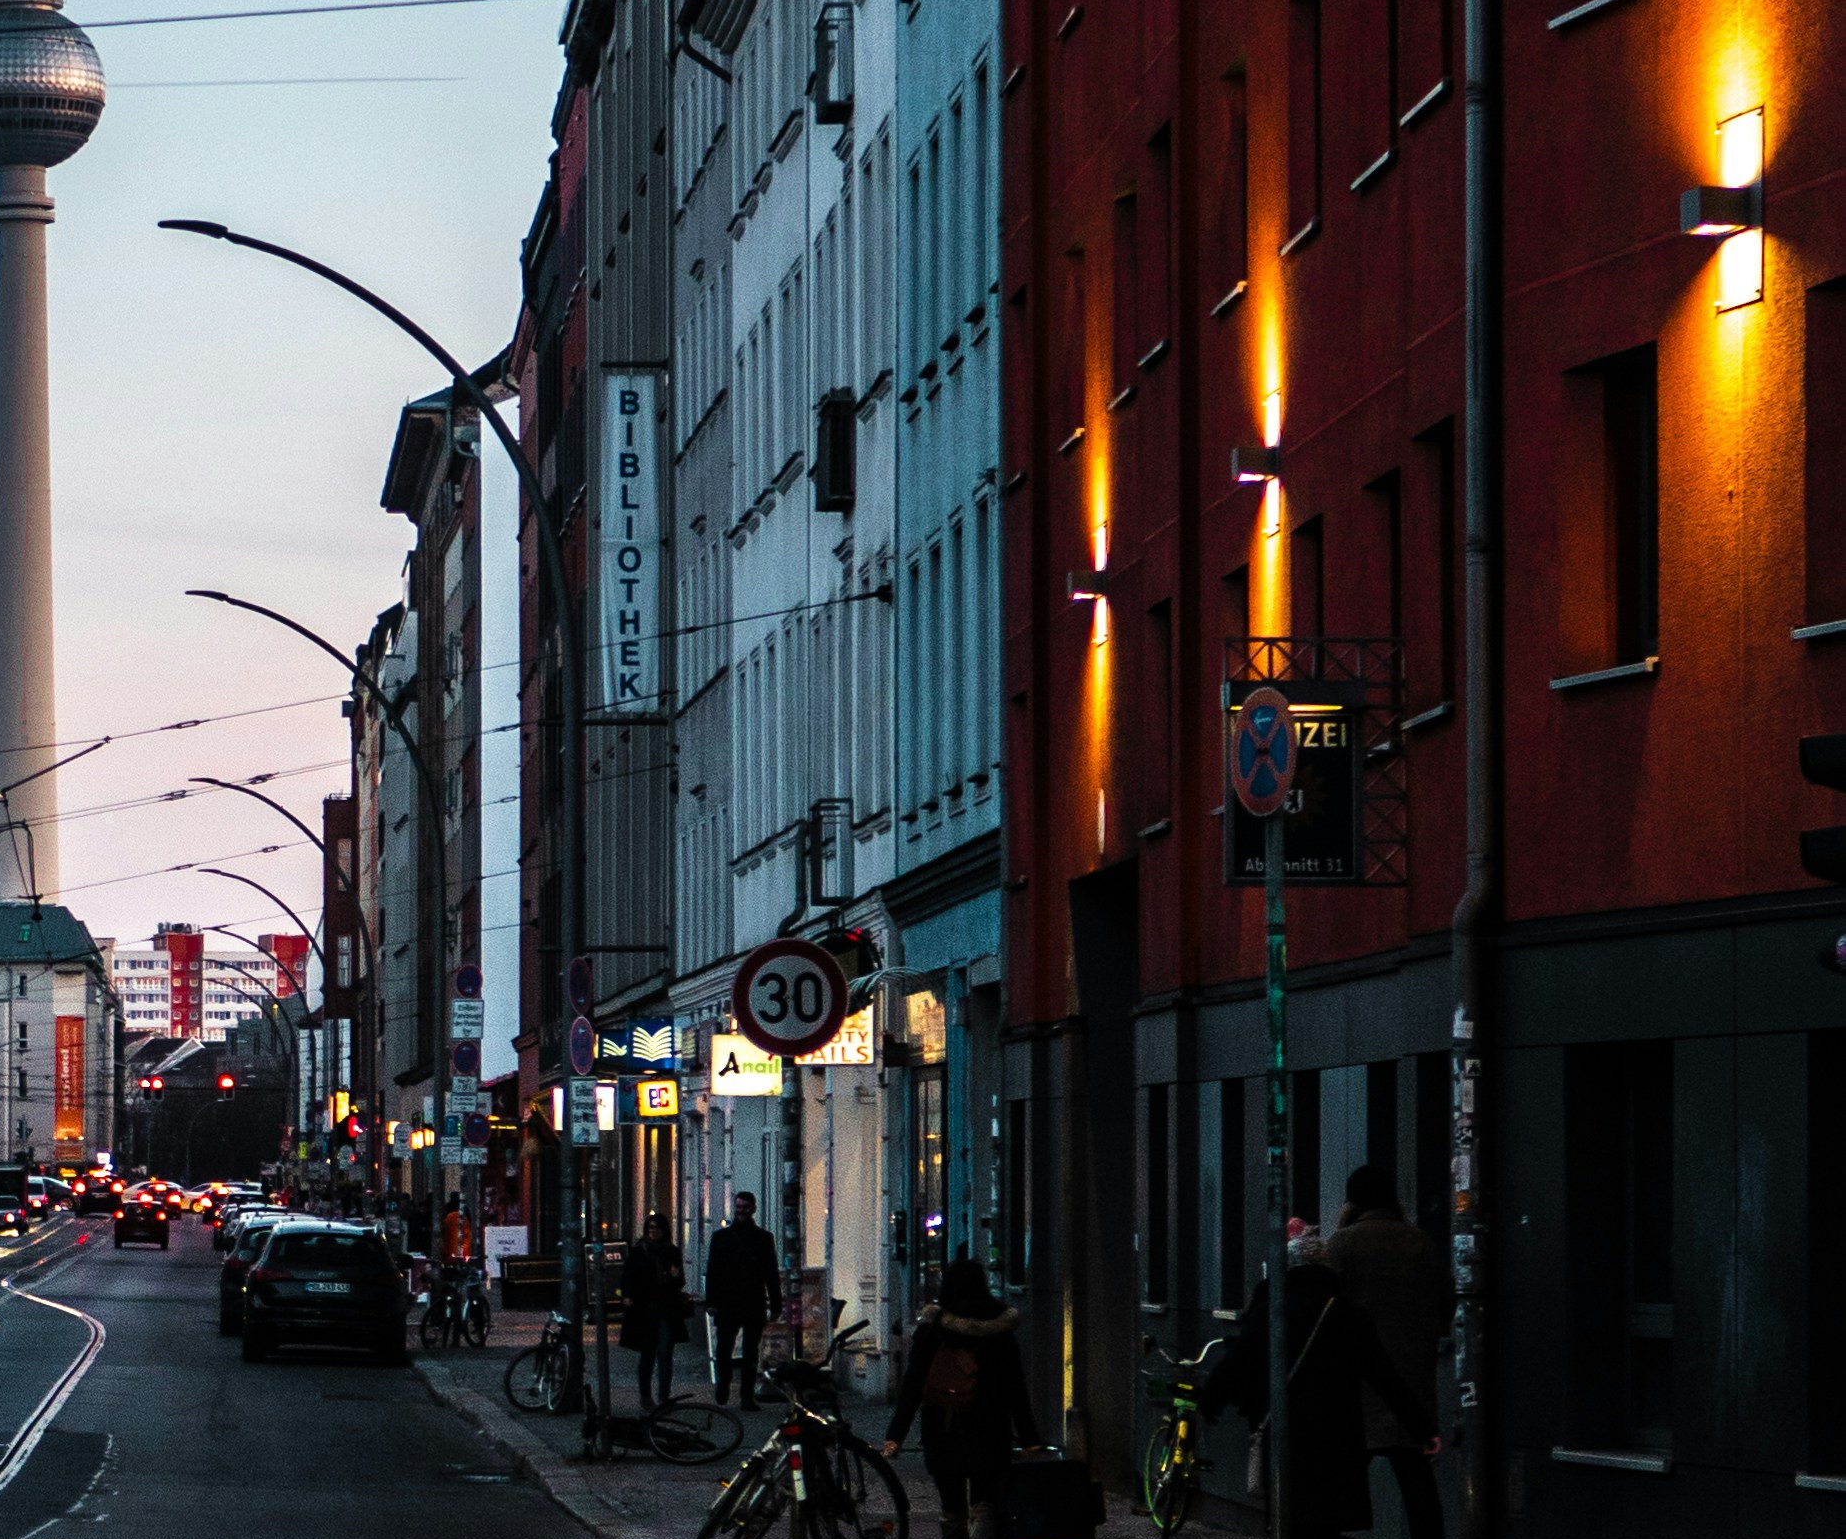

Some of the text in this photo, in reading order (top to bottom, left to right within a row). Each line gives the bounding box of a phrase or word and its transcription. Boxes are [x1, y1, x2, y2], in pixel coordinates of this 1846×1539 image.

[616, 389, 642, 698] BIBLIOTHEK
[1245, 857, 1344, 872] Abnitt 31
[757, 971, 824, 1024] 30
